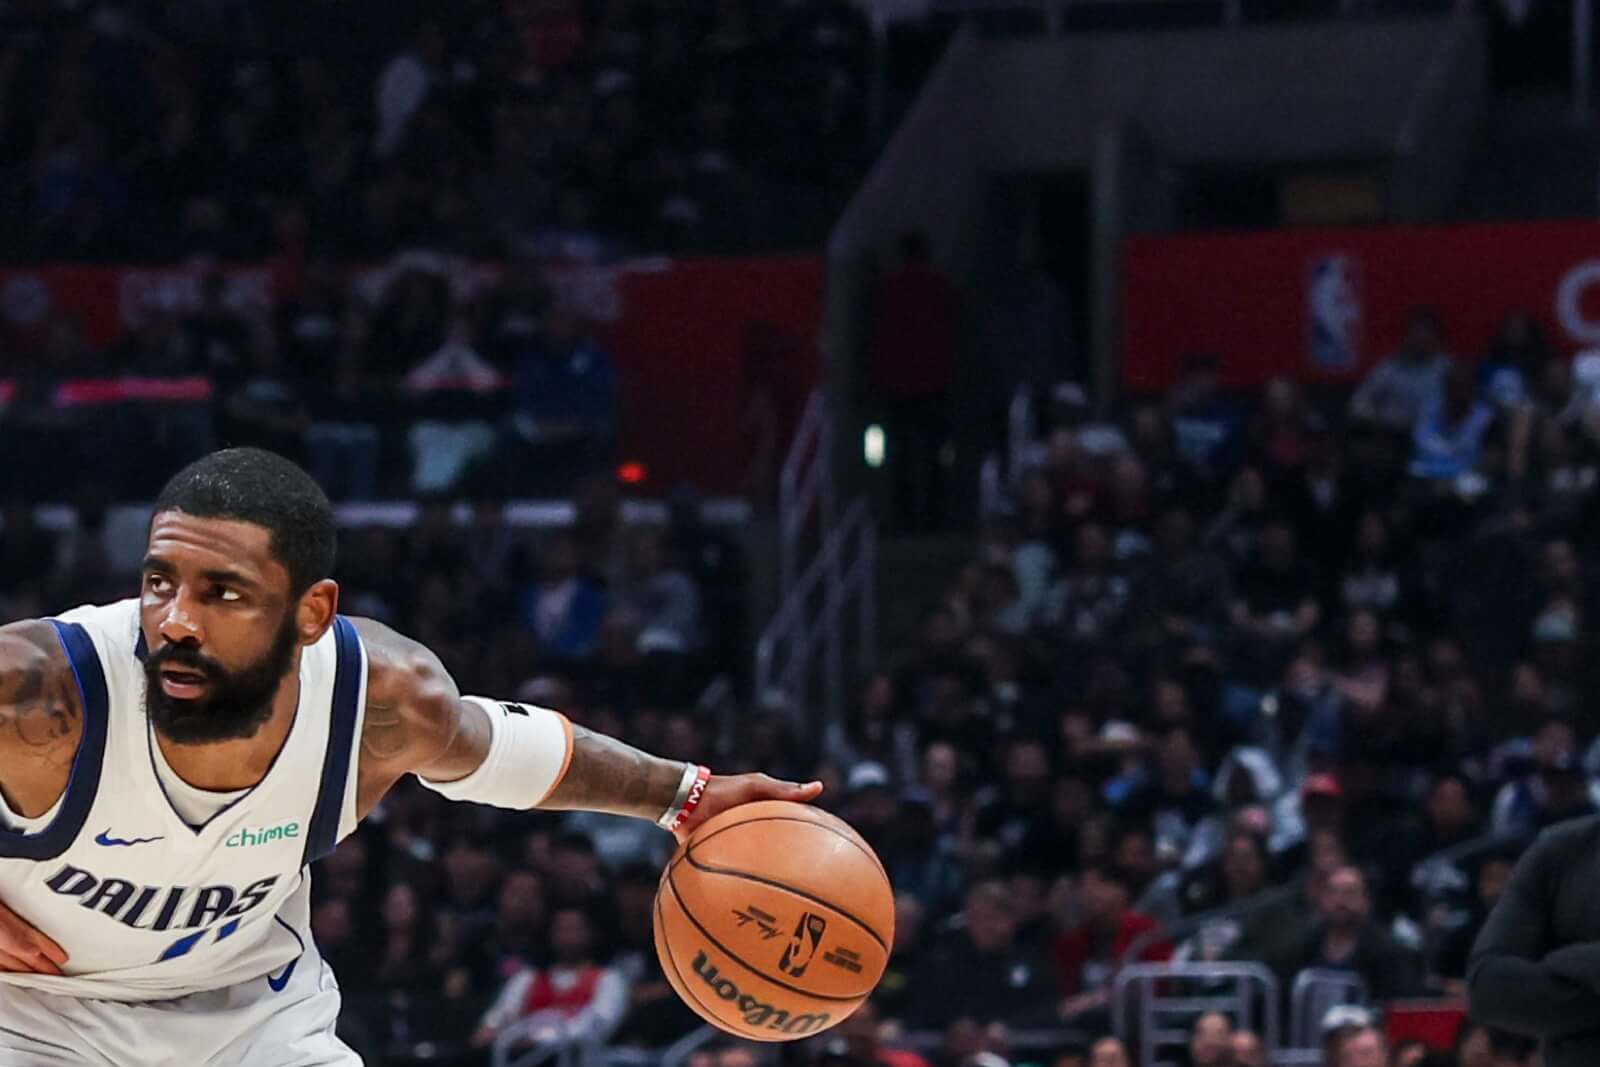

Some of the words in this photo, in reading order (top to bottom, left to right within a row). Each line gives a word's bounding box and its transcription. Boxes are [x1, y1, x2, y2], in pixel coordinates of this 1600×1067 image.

[225, 821, 299, 848] chime
[44, 863, 282, 931] DALLAS
[691, 948, 832, 1034] Wilson
